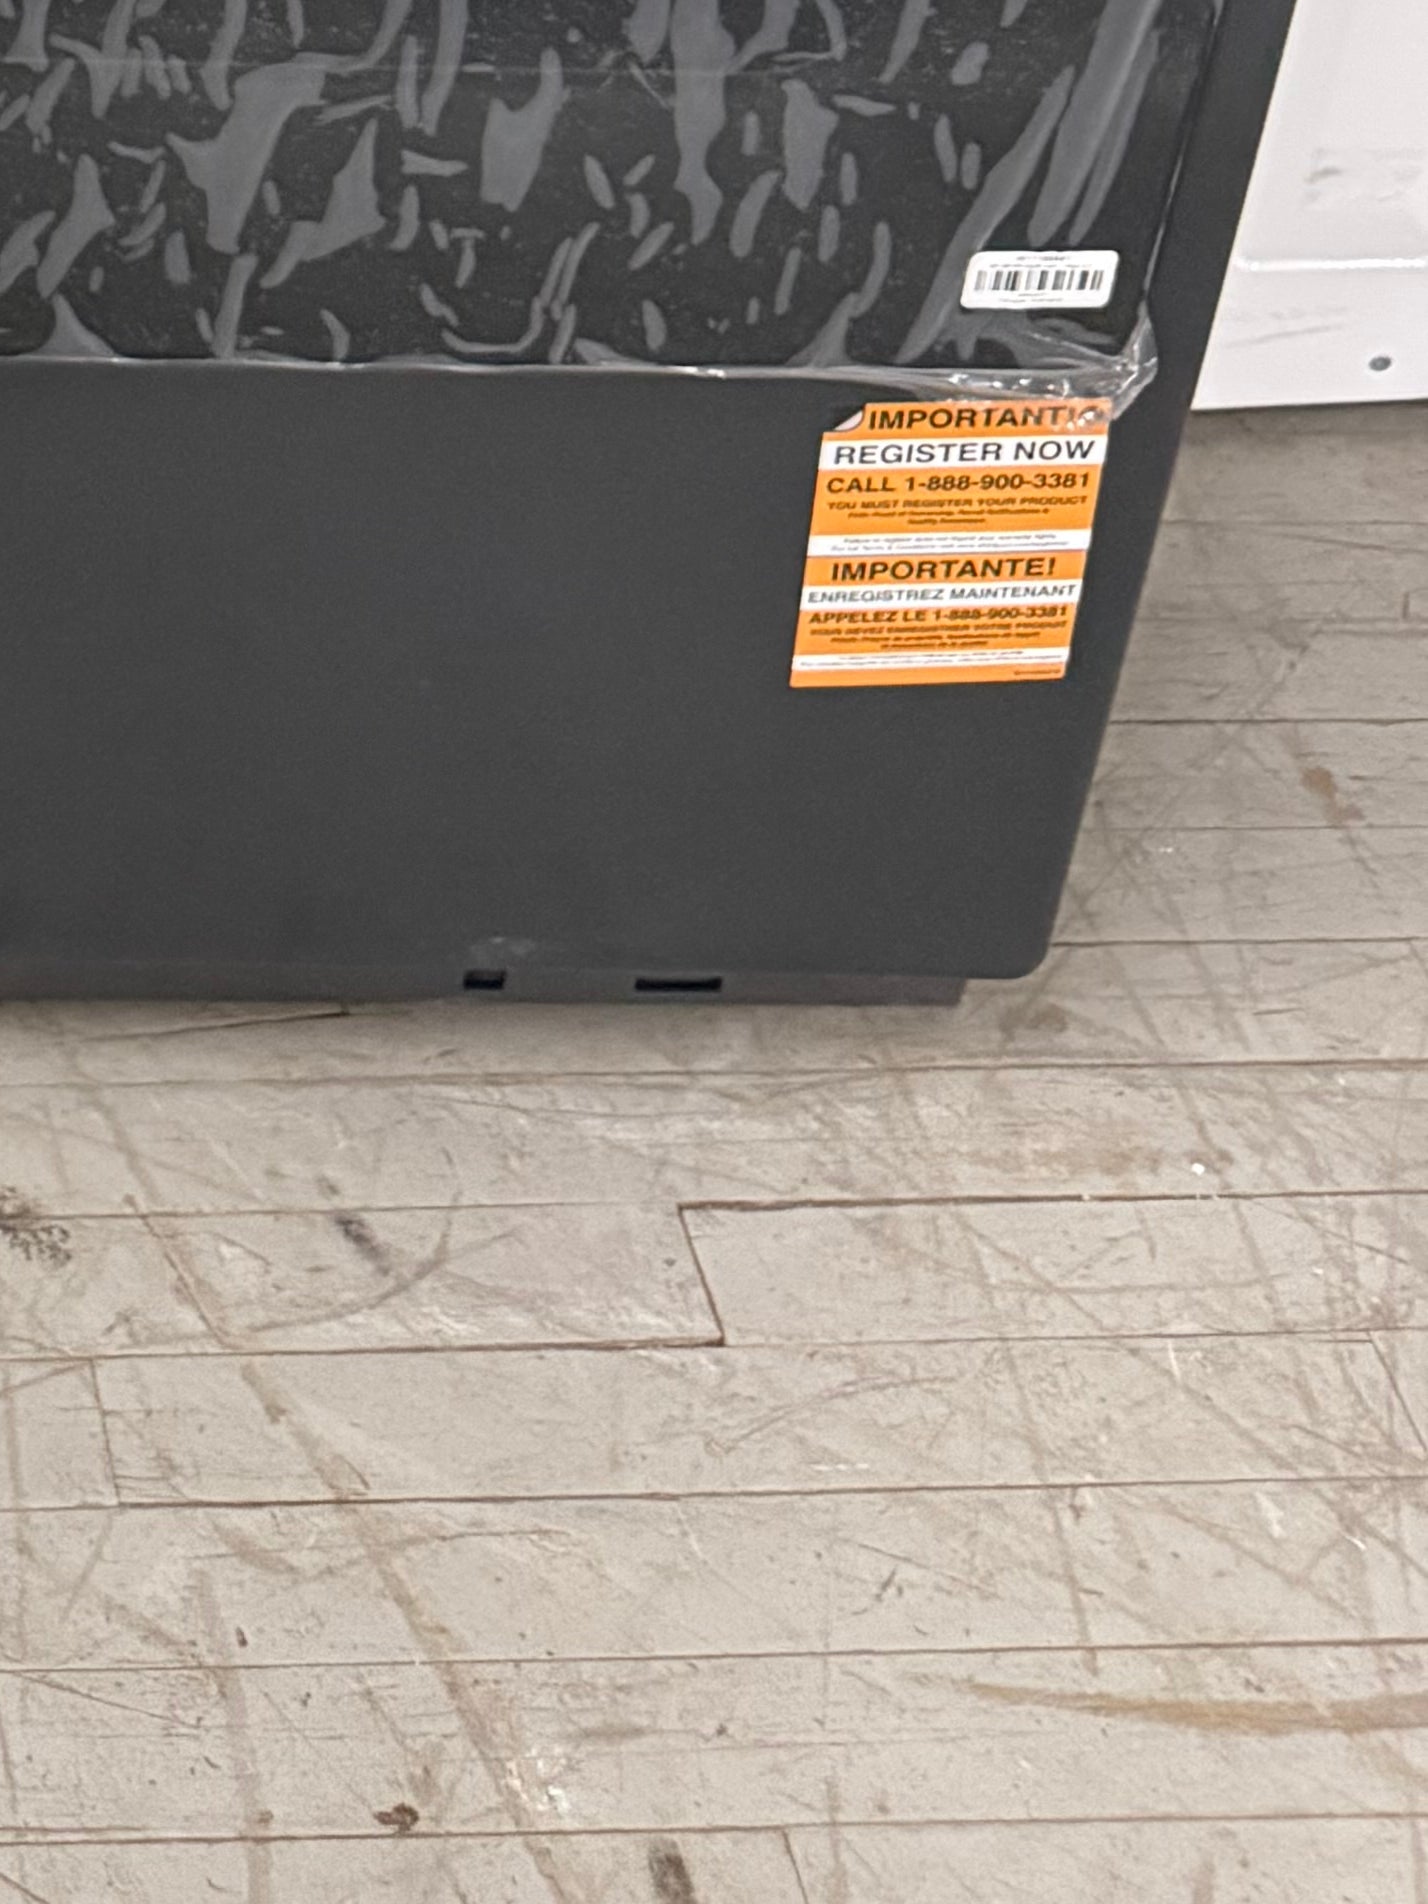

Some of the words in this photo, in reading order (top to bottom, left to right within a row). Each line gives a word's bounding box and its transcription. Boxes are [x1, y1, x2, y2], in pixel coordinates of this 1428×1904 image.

[834, 442, 1001, 465] REGISTER
[1014, 440, 1095, 461] NOW
[826, 476, 894, 494] CALL
[906, 472, 1090, 491] 1-888-900-3381
[827, 501, 858, 509] YOU
[860, 500, 898, 509] MUST
[902, 497, 975, 508] REGISTER
[977, 497, 1016, 507] YOUR
[1019, 495, 1088, 505] PRODUCT
[831, 557, 1057, 581] IMPORTANTE!
[807, 589, 944, 604] ENREGISTREZ
[949, 584, 1077, 599] MAINTENANT
[808, 608, 897, 624] APPELEZ
[902, 608, 926, 622] LE
[933, 605, 1067, 621] 1-888-900-3381
